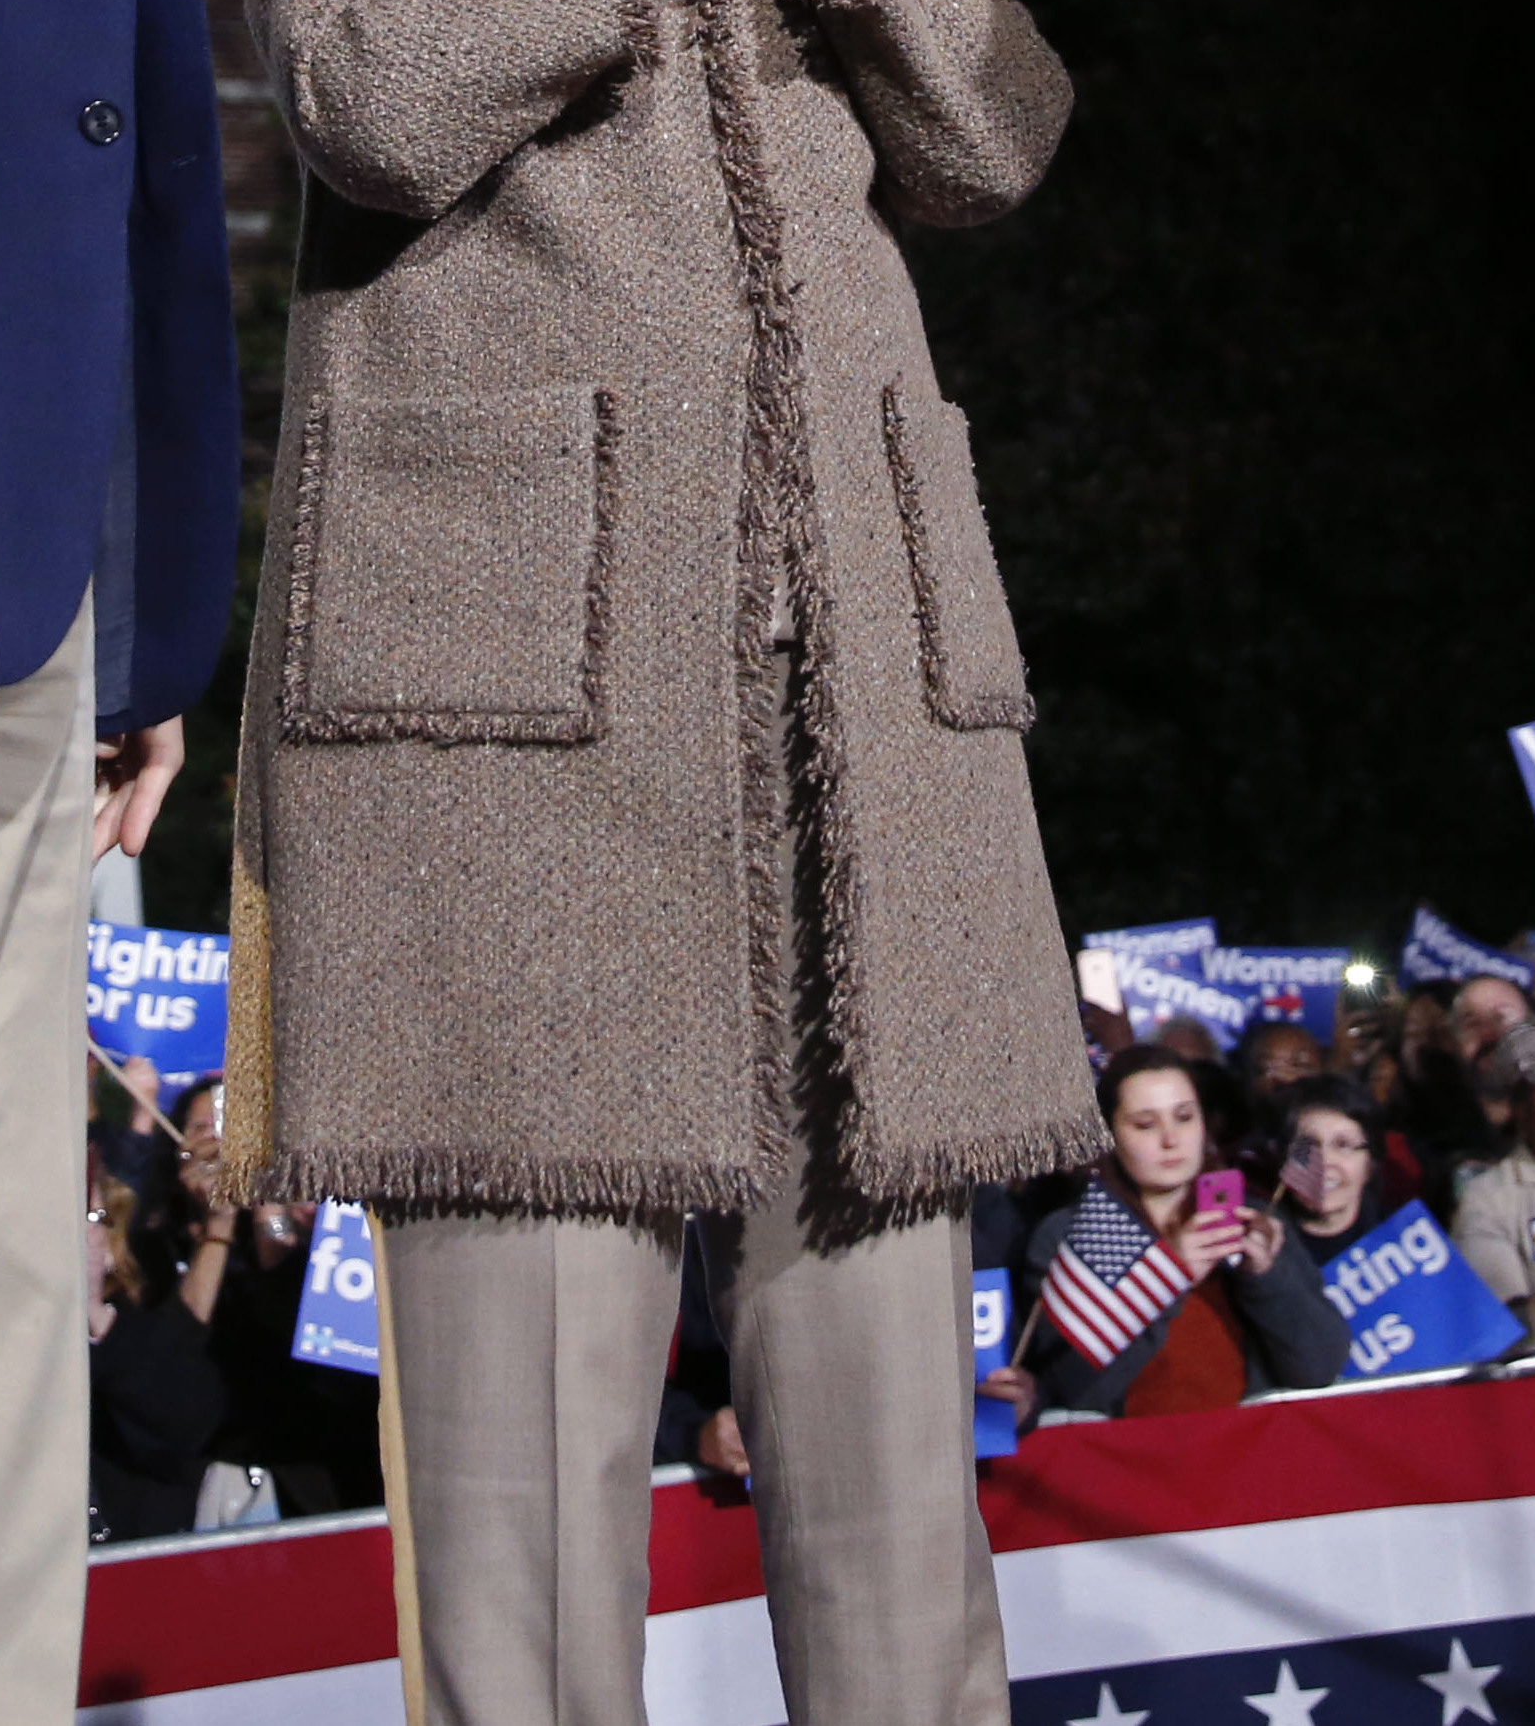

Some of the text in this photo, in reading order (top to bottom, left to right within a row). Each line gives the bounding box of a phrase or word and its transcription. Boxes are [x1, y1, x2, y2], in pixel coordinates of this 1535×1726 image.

[1201, 946, 1347, 986] Women
[87, 982, 198, 1031] or us
[310, 1236, 375, 1303] fo
[1323, 1217, 1450, 1319] ting
[1349, 1313, 1415, 1372] us
